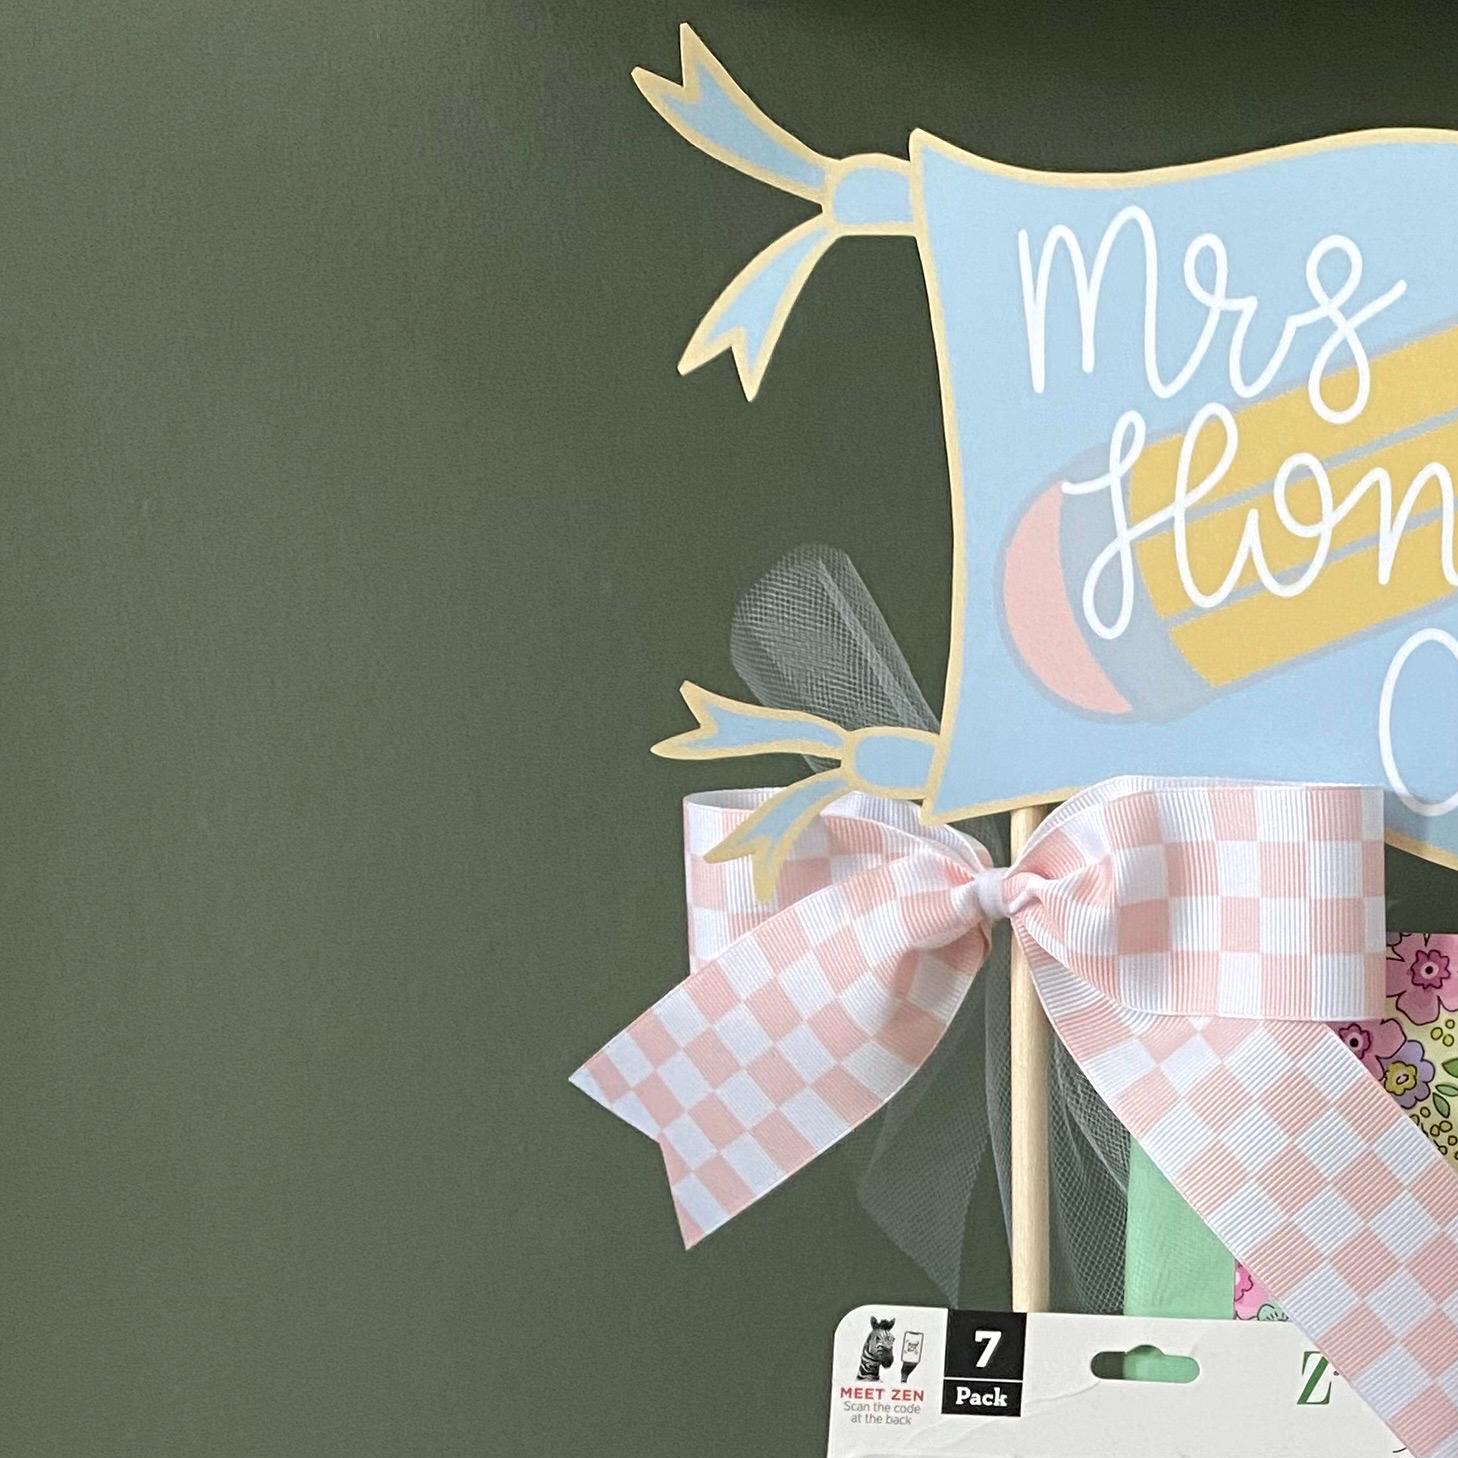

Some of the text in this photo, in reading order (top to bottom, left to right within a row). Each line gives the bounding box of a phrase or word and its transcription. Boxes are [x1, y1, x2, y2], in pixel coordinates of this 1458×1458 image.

[1018, 205, 1407, 425] Mrs
[974, 1330, 1002, 1368] 7
[840, 1387, 924, 1401] MEET ZEN
[955, 1386, 1008, 1407] Pack
[843, 1401, 921, 1414] Scan the code
[851, 1413, 912, 1425] at the back
